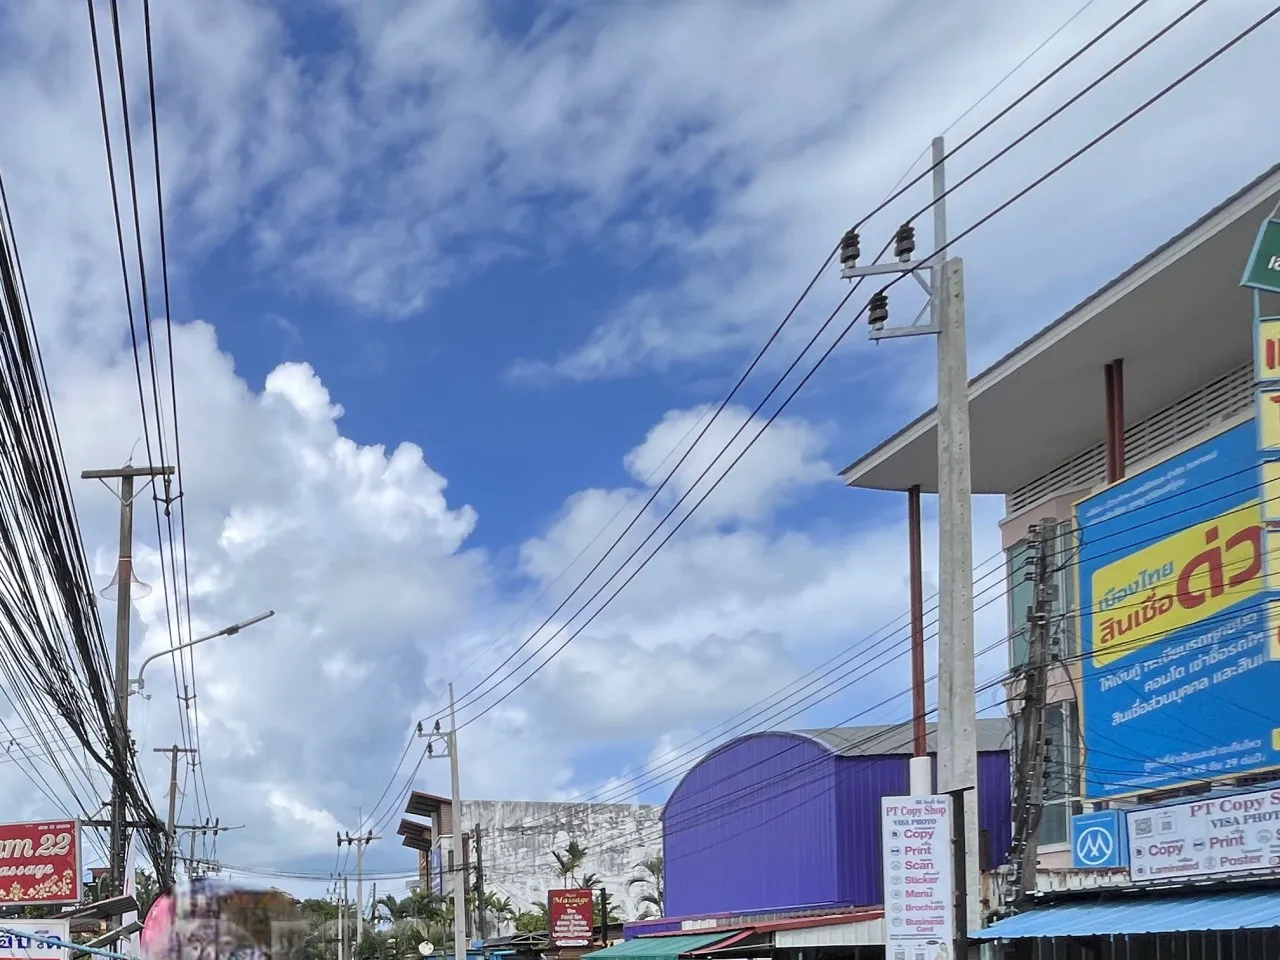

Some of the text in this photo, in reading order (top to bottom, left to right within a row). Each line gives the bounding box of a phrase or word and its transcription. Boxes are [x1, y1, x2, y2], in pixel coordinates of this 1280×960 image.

[886, 804, 947, 818] PT Copy Shop
[1189, 802, 1215, 818] PT
[1220, 797, 1265, 813] Copy
[911, 818, 937, 826] PHOTO
[1210, 817, 1240, 829] VISA
[904, 829, 934, 840] Copy
[35, 832, 72, 857] 22
[1148, 835, 1246, 857] Copy Print
[904, 846, 932, 856] Print
[904, 860, 934, 870] Scan
[1219, 854, 1264, 867] Poster
[904, 876, 940, 885] Sticker
[905, 889, 933, 898] Menu
[905, 903, 946, 912] Brochure
[905, 918, 945, 926] Business
